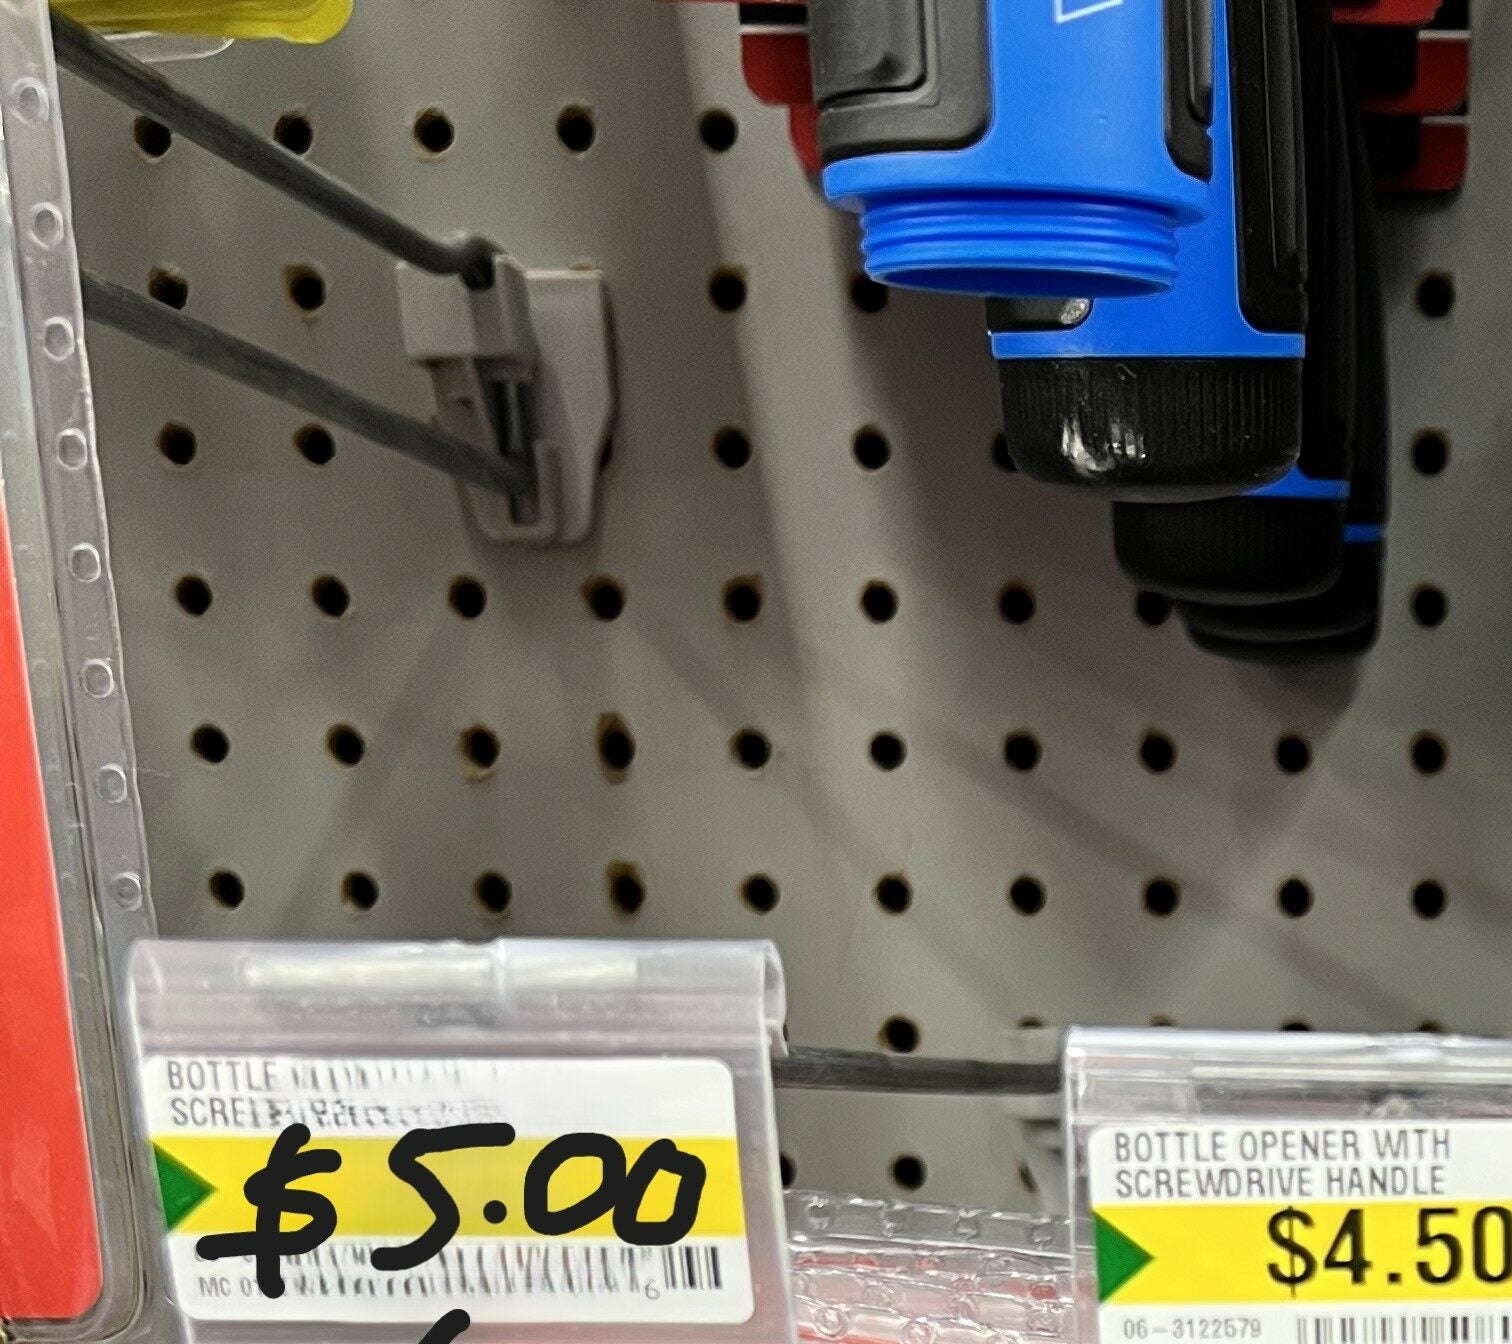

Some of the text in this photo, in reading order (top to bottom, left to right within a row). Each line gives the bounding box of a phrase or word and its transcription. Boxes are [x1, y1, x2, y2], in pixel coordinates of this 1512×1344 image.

[1114, 1128, 1450, 1162] BOTTLE OPENER WITH
[1115, 1166, 1446, 1199] SCREWDRIVE HANDLE
